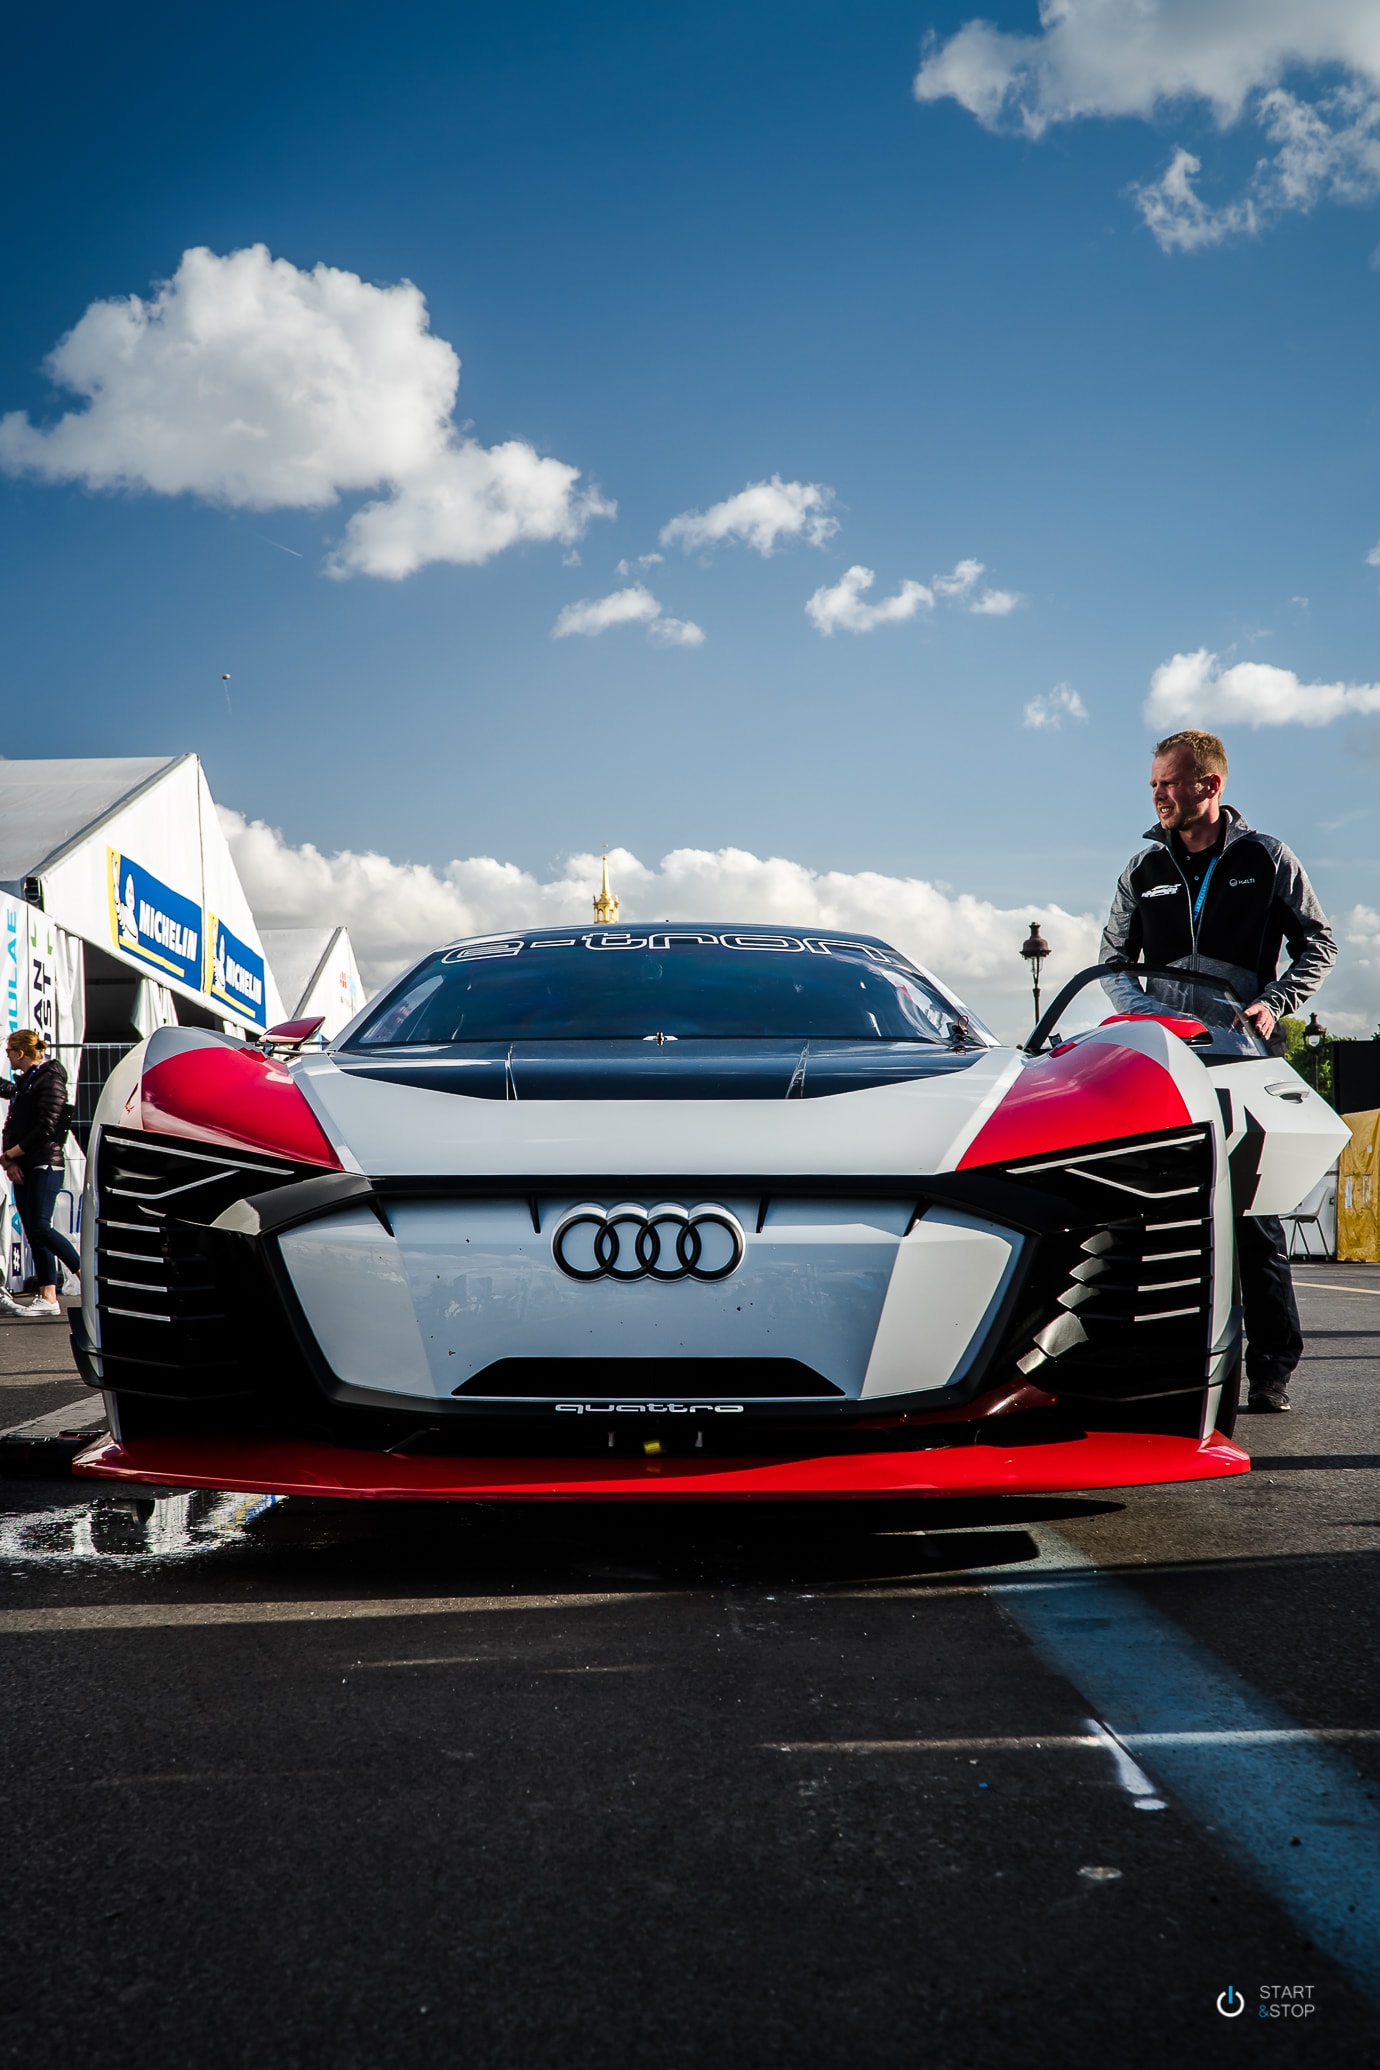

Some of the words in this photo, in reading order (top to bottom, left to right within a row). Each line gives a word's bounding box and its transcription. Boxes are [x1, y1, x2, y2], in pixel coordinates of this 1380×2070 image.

[139, 899, 198, 962] MICHELIN
[440, 932, 892, 963] e-tron
[226, 955, 262, 1005] MICHELIN
[555, 1403, 744, 1414] quattro
